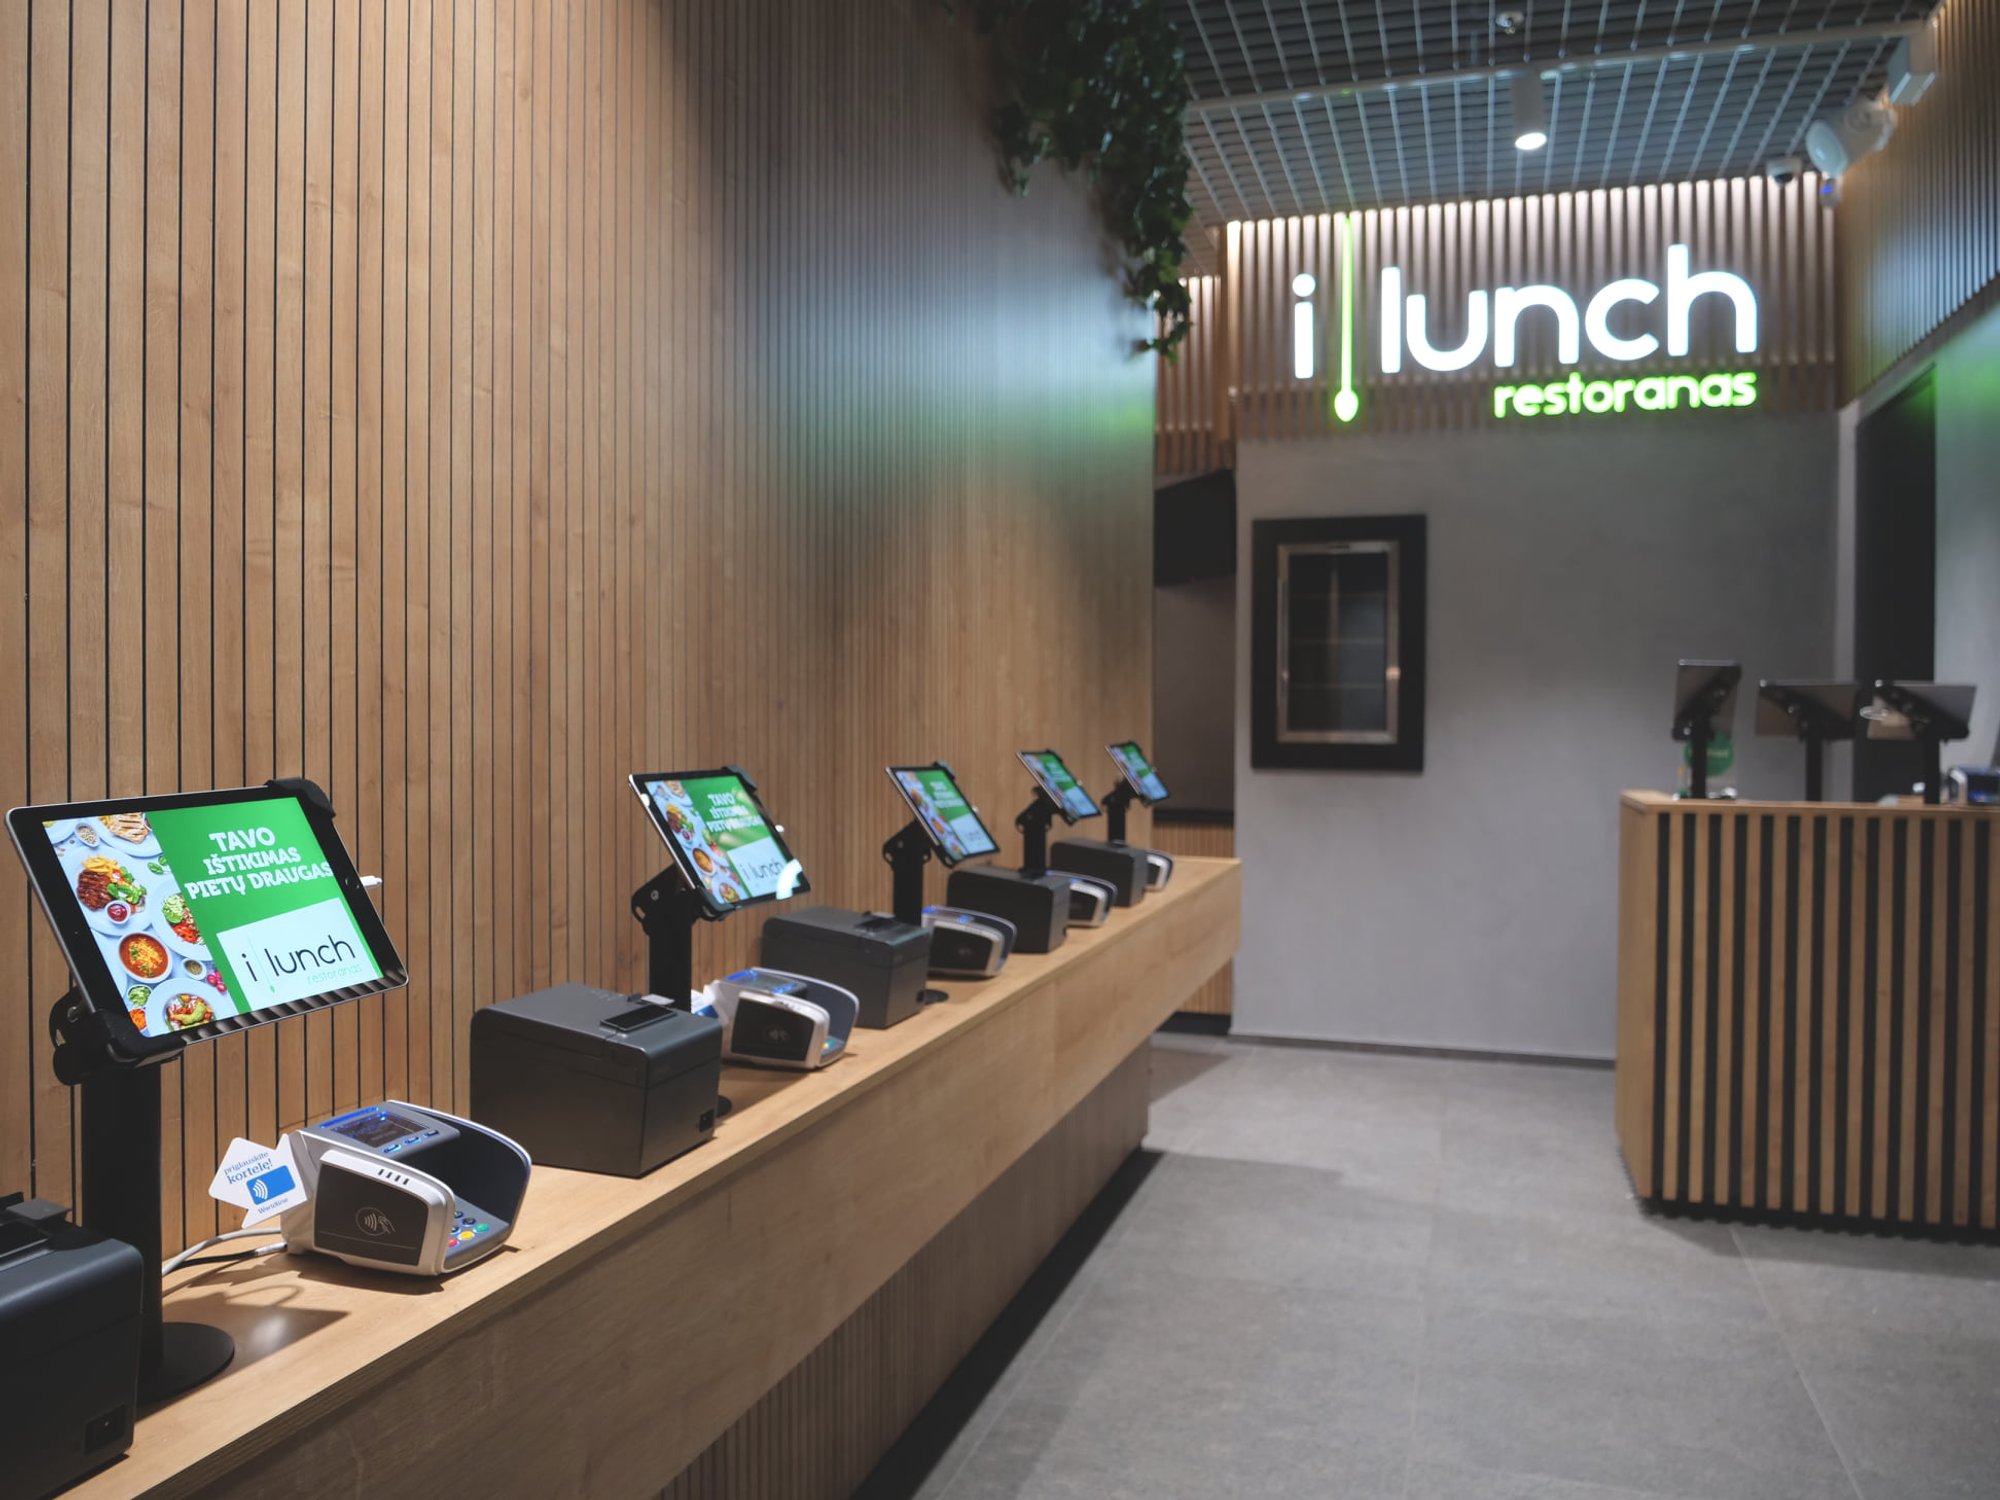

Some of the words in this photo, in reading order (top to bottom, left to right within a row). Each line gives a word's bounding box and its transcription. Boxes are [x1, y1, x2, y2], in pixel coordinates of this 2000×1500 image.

[1292, 273, 1316, 379] i
[1381, 243, 1757, 374] lunch
[1493, 372, 1757, 418] restoranas
[208, 827, 276, 852] TAVO
[184, 875, 247, 900] PIETŲ
[247, 861, 334, 890] DRAUGAS
[203, 846, 302, 876] IŠTIKIMAS
[241, 952, 258, 982] i
[264, 934, 356, 977] lunch
[307, 963, 362, 984] restoranas
